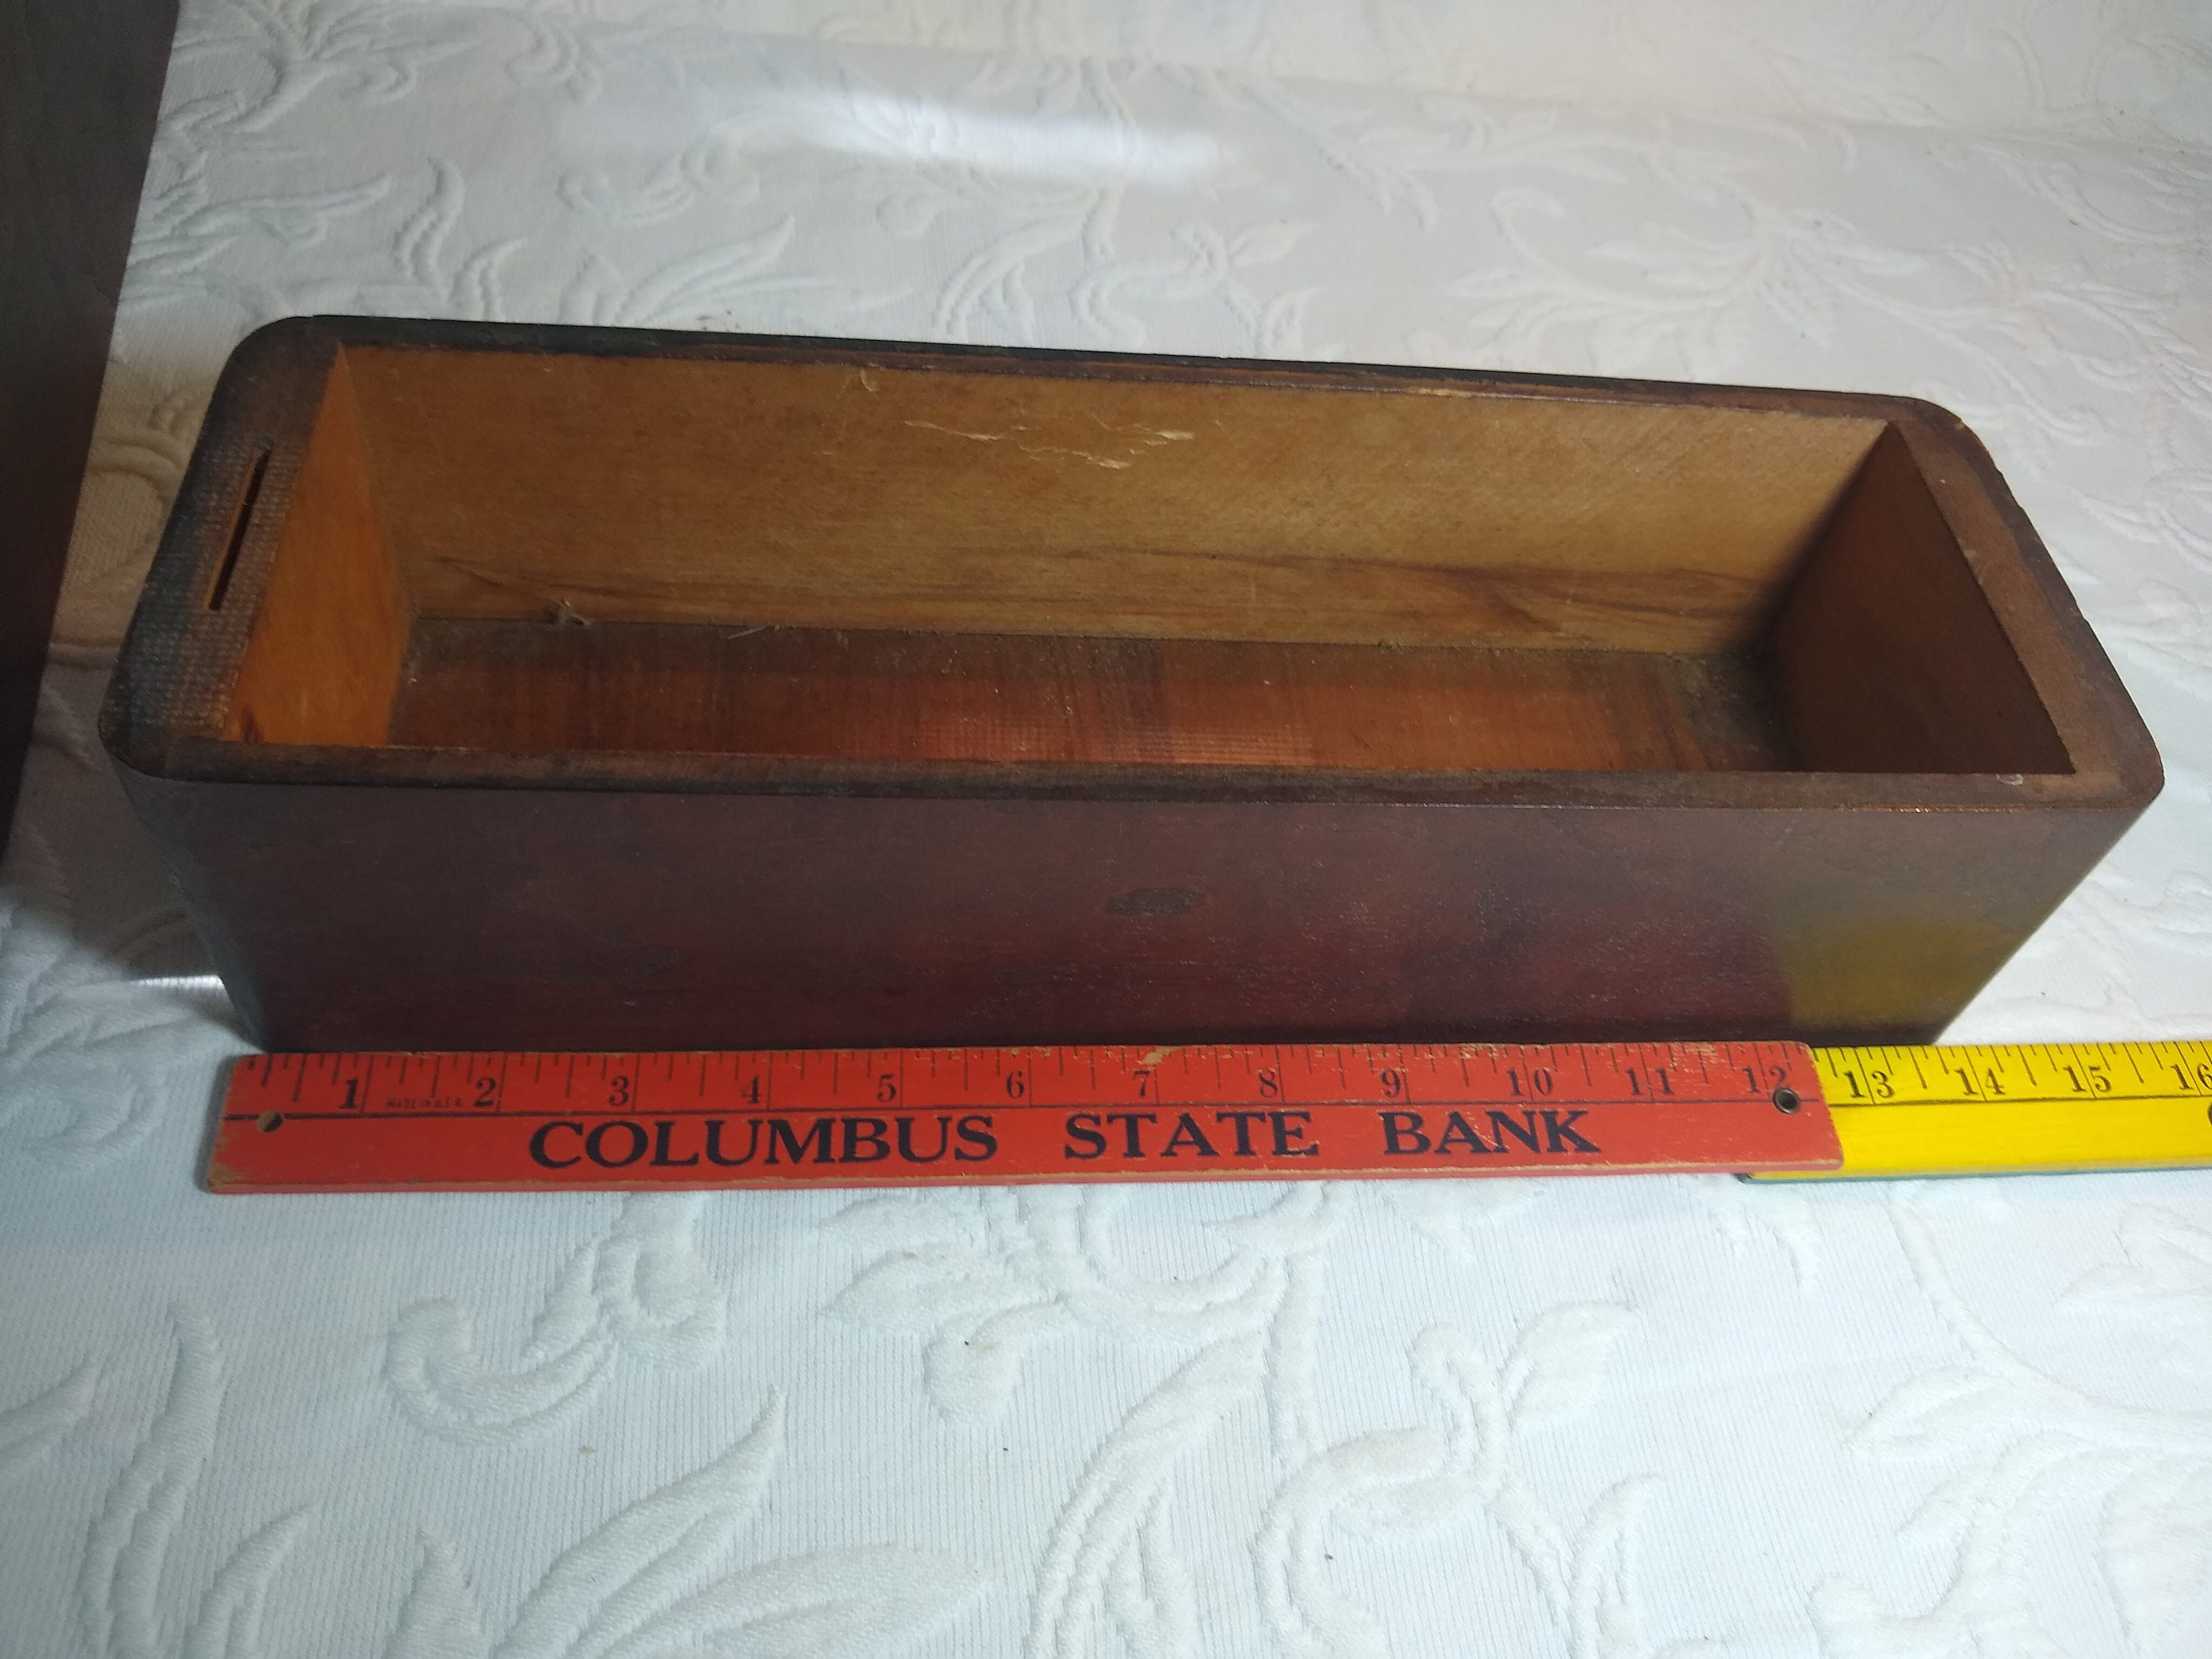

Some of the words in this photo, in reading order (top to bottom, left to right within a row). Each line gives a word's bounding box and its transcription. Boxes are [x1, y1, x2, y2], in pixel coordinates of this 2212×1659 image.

[340, 1079, 357, 1109] 1
[473, 1077, 497, 1107] 2
[608, 1076, 630, 1107] 3
[740, 1075, 761, 1105] 4
[877, 1075, 897, 1103] 5
[1006, 1071, 1025, 1099] 6
[1133, 1071, 1150, 1098] 7
[1259, 1069, 1279, 1096] 8
[1380, 1069, 1401, 1097] 9
[1506, 1068, 1553, 1096] 10
[1626, 1068, 1676, 1096] 11
[1843, 1071, 1896, 1099] 13
[1955, 1068, 2006, 1096] 14
[2063, 1065, 2112, 1093] 15
[529, 1114, 998, 1169] COLUMBUS
[1064, 1111, 1319, 1159] STATE
[1379, 1110, 1601, 1155] BANK
